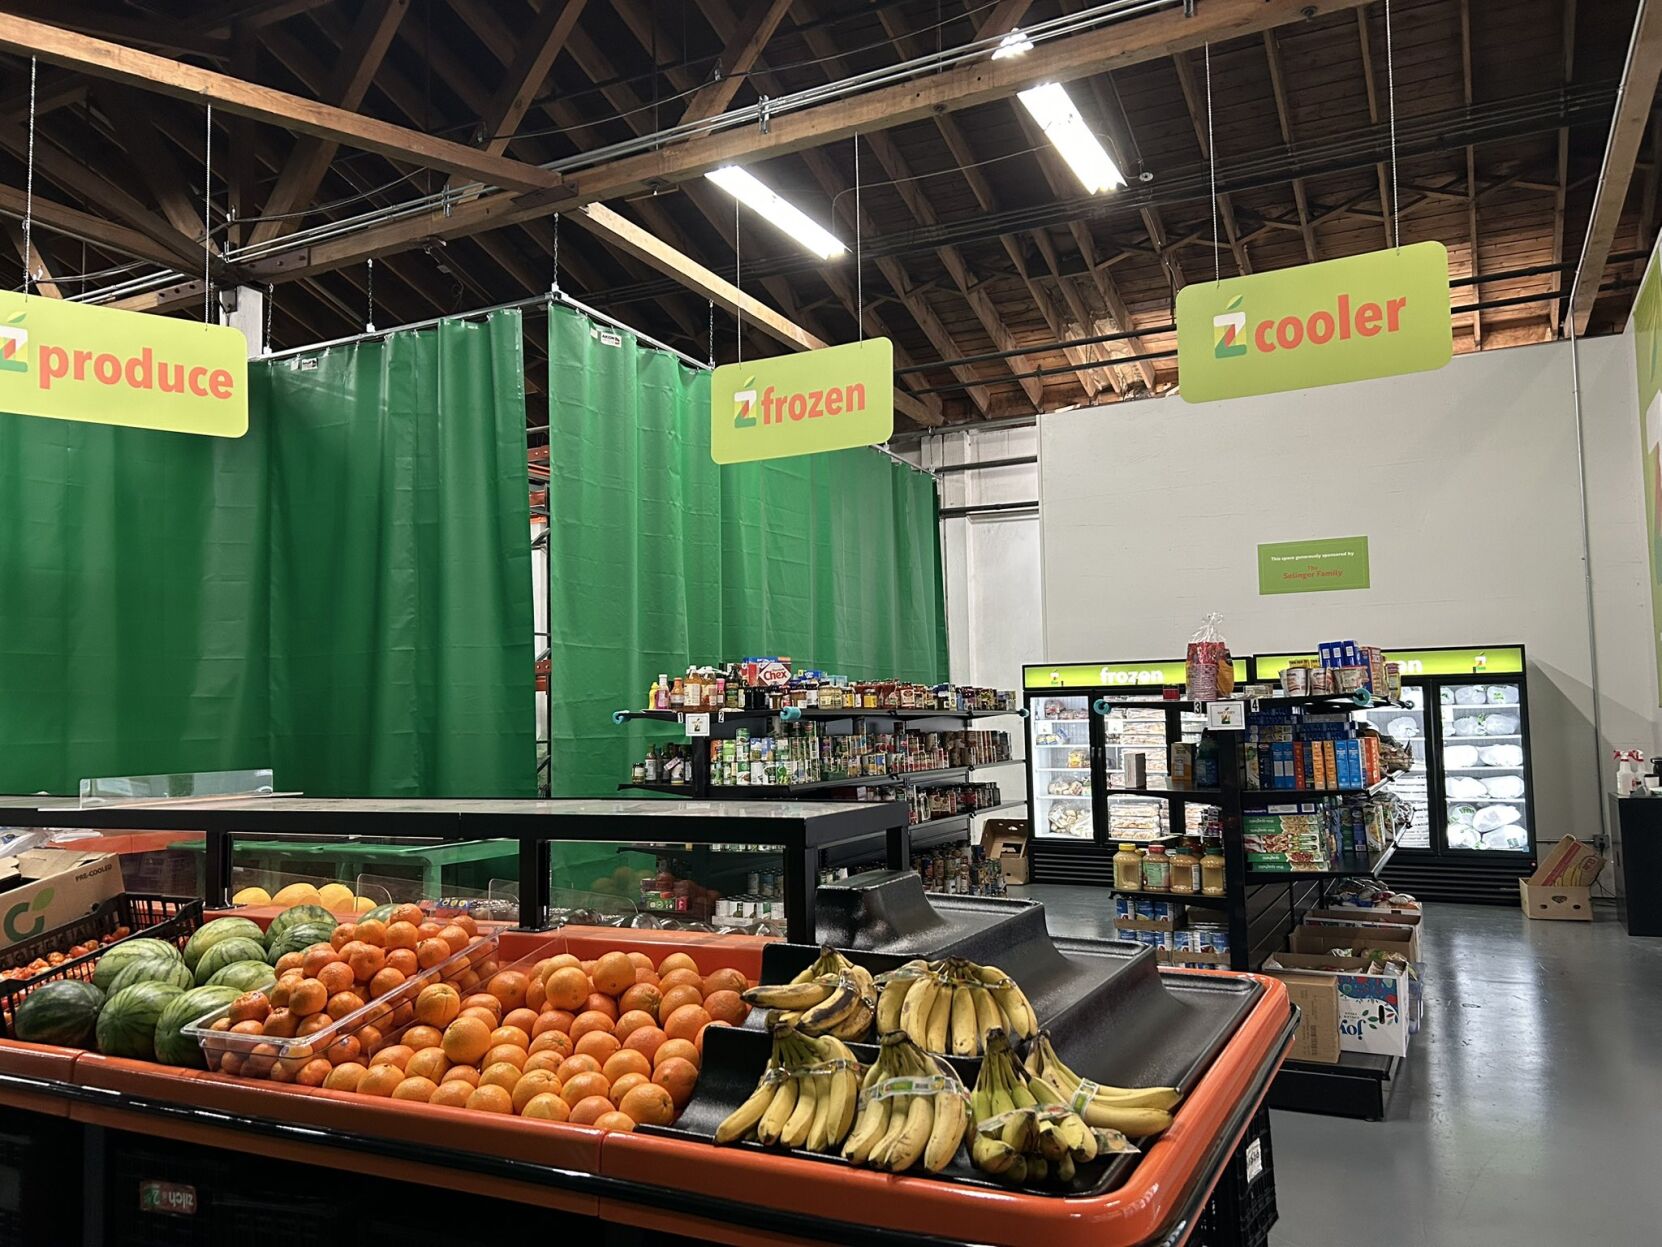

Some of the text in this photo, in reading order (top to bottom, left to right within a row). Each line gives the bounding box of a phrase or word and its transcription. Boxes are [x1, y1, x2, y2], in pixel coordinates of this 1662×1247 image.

[1254, 293, 1407, 353] cooler
[39, 343, 234, 400] produce
[761, 382, 866, 425] frozen
[1295, 553, 1321, 561] generously
[1316, 569, 1344, 577] Family
[763, 670, 787, 680] Chex
[1099, 666, 1164, 685] frozen
[1194, 701, 1201, 714] 3
[75, 863, 112, 882] PRE-COOLED
[1339, 1019, 1367, 1041] joy
